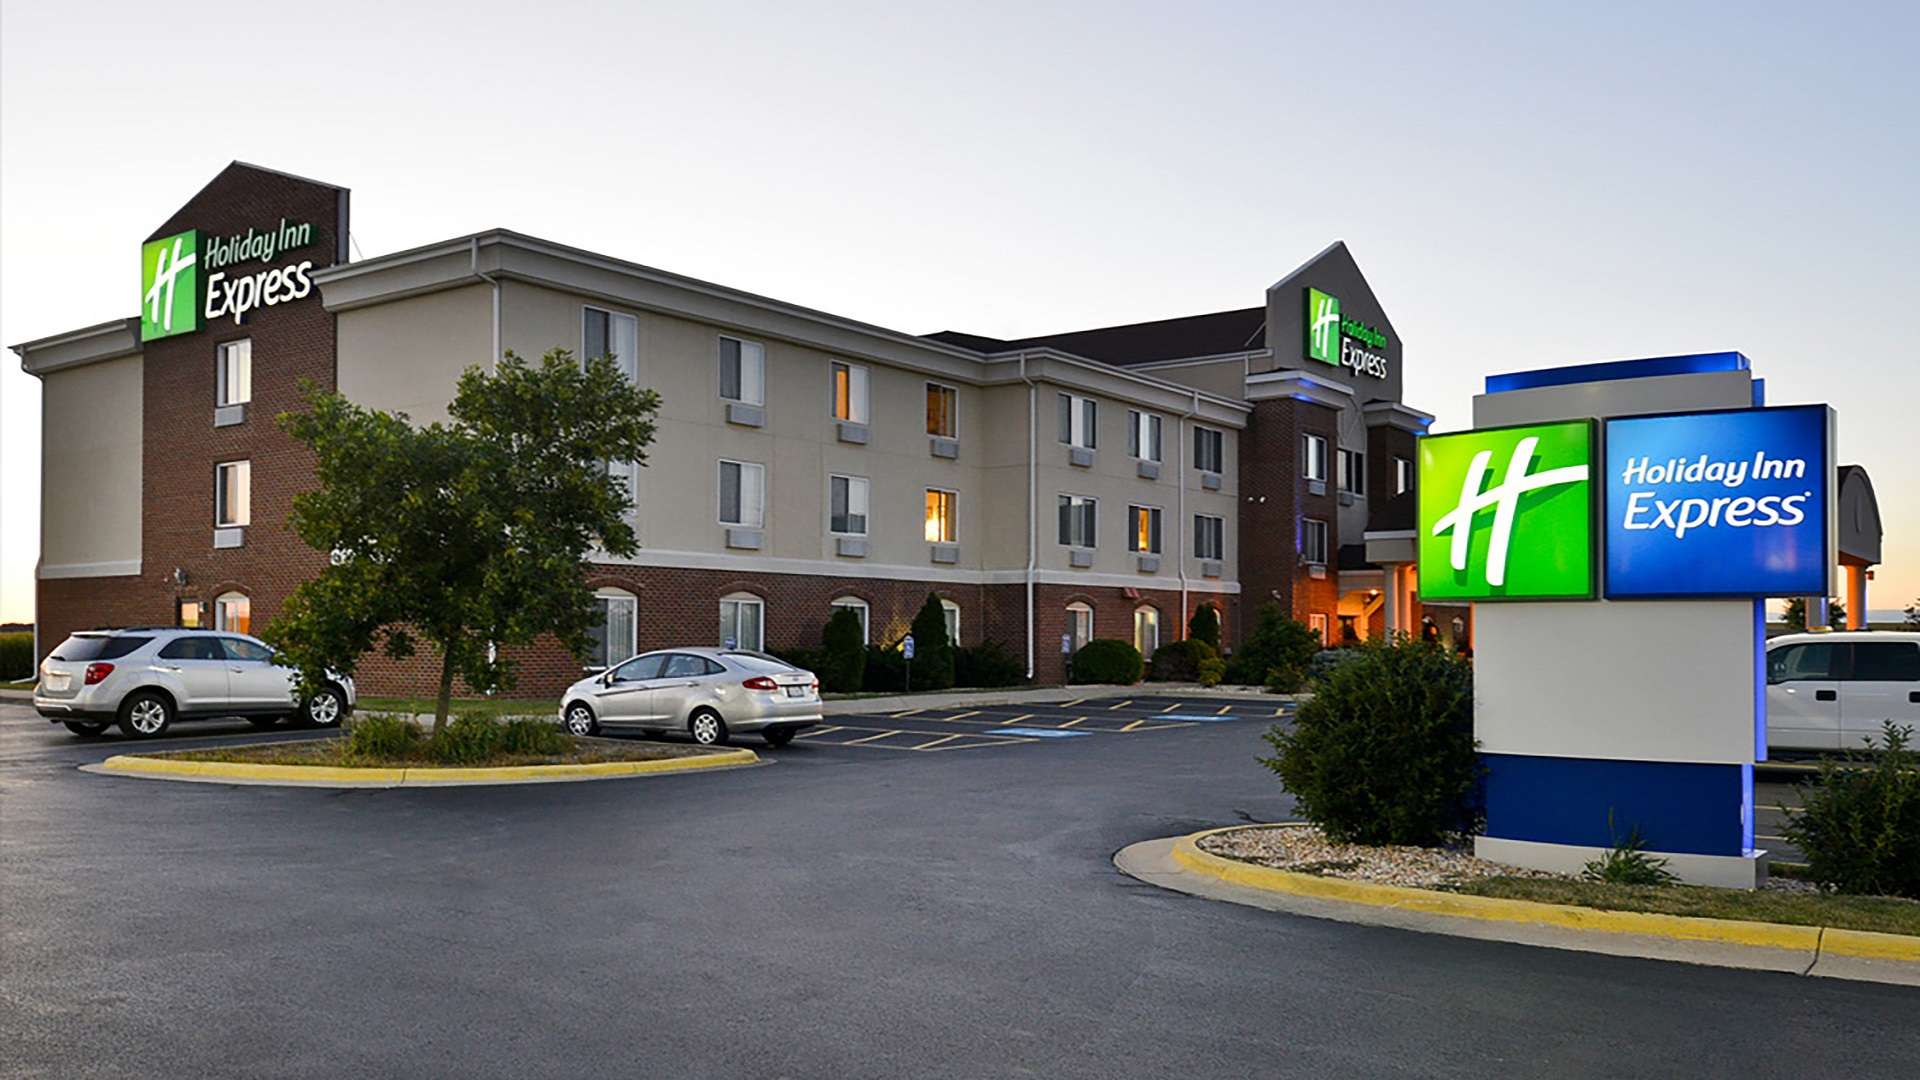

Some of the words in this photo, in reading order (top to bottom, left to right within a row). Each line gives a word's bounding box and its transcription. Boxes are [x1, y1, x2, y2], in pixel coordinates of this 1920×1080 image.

[204, 228, 276, 269] Holiday
[278, 218, 310, 251] Inn
[205, 261, 312, 325] Express
[1341, 337, 1387, 379] Express
[1622, 454, 1748, 487] Holiday
[1751, 451, 1805, 480] Inn
[1623, 491, 1806, 539] Express
